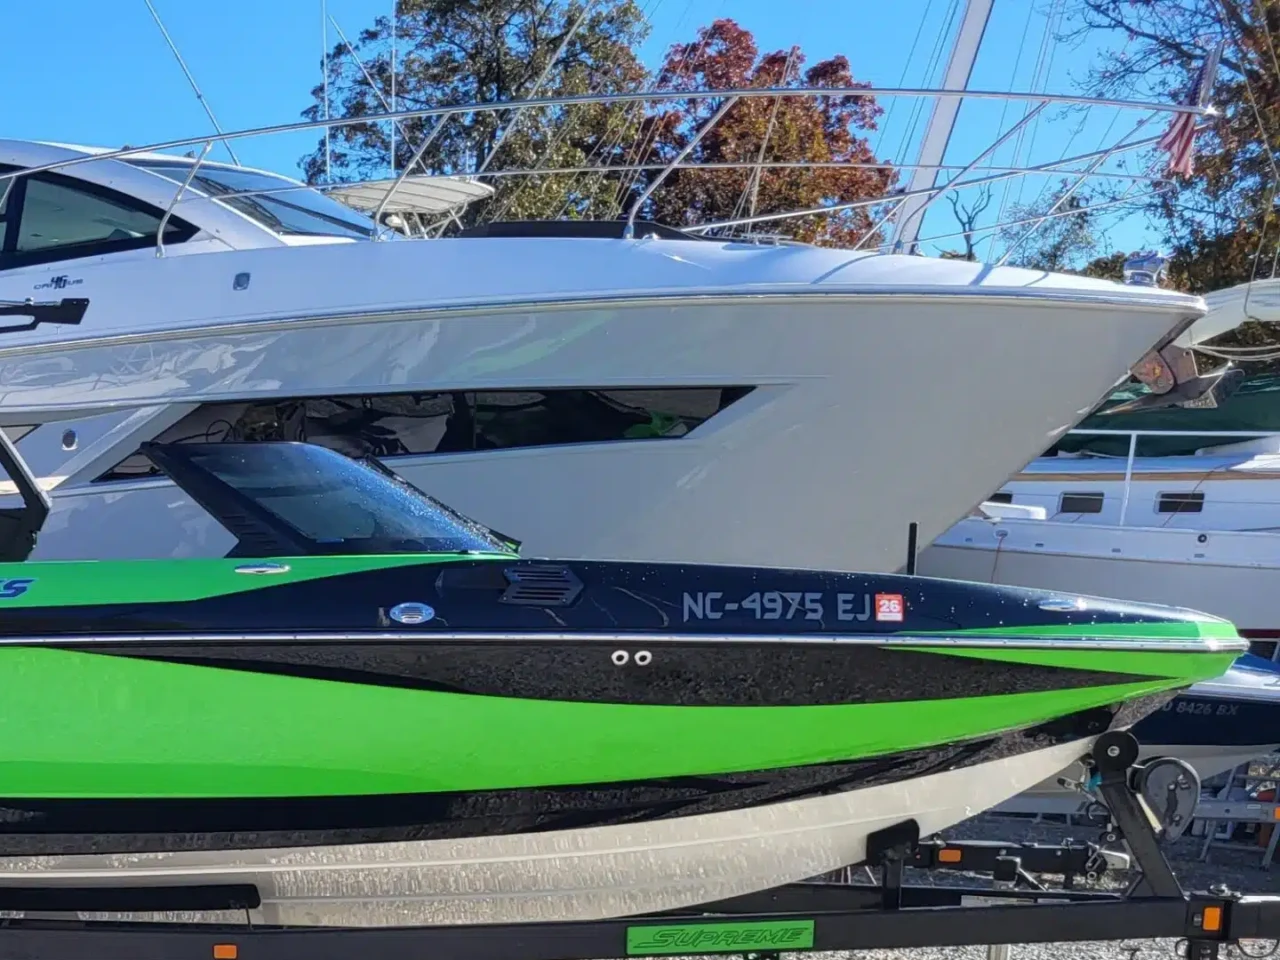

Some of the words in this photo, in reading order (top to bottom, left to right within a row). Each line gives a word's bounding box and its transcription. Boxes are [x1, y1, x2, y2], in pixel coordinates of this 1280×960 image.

[683, 592, 823, 622] NC-4975
[837, 593, 870, 621] EJ
[879, 599, 900, 612] 26
[633, 927, 808, 948] SUPREME
